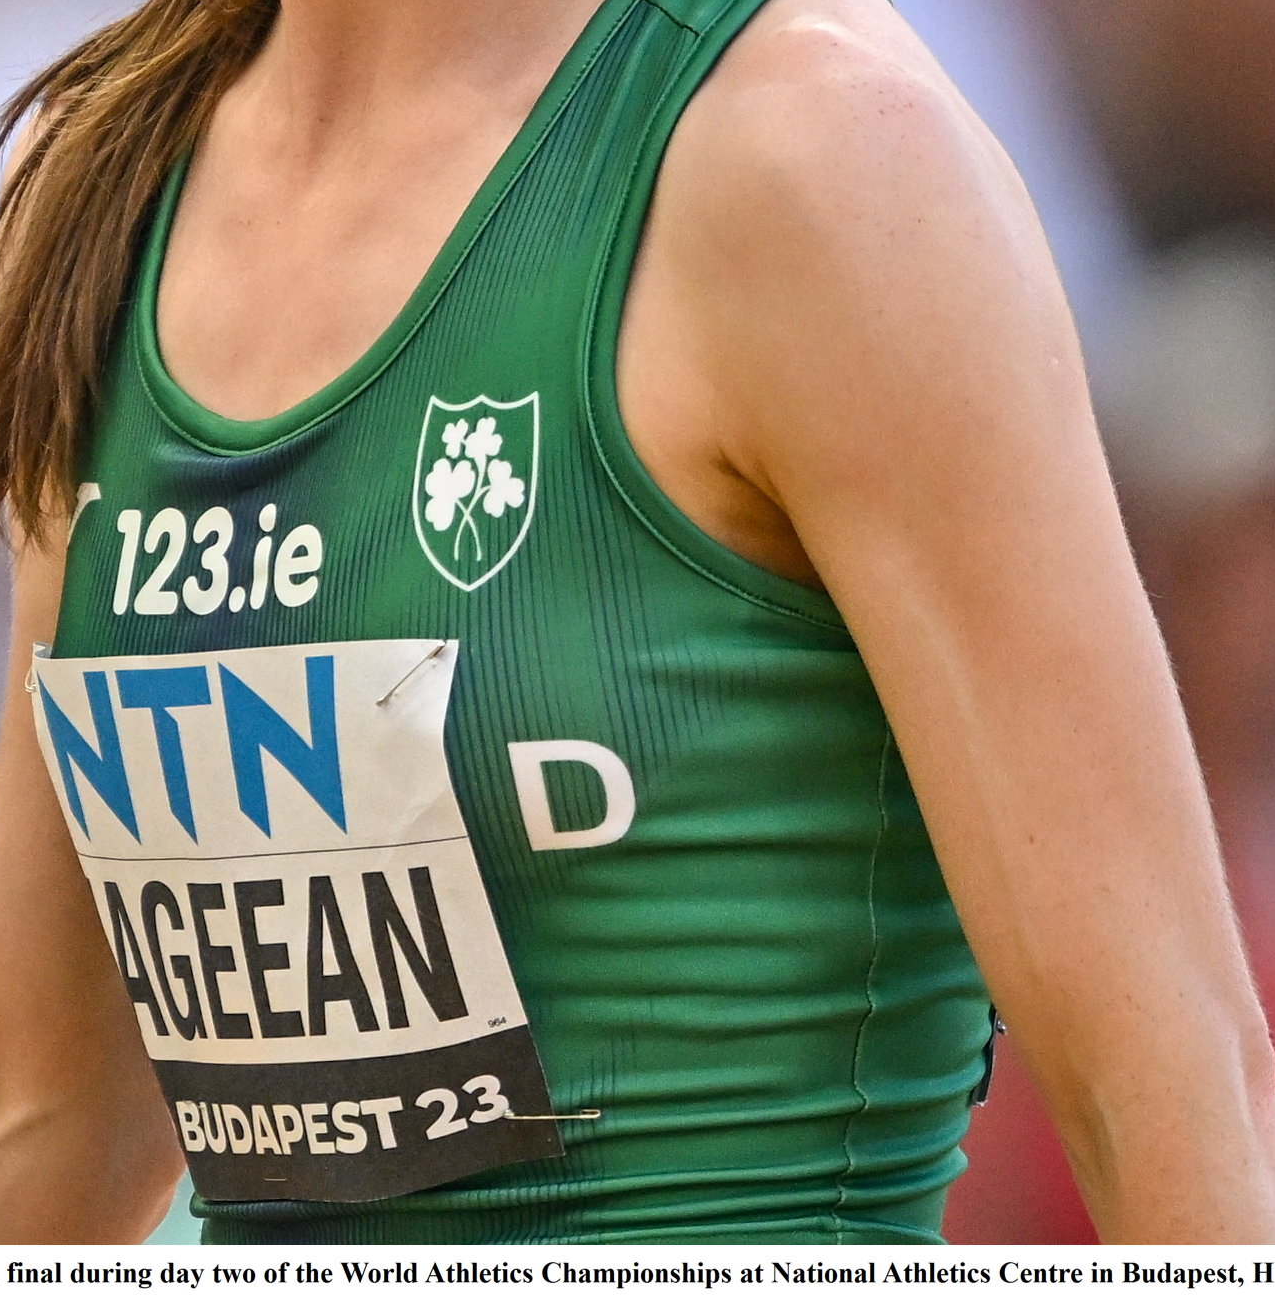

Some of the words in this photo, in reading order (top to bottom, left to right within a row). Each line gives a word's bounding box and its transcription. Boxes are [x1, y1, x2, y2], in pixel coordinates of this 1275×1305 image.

[112, 503, 323, 616] 123.ie
[36, 655, 348, 847] NTN
[507, 739, 636, 851] D
[86, 866, 469, 1041] AGEEAN
[175, 1096, 403, 1155] BUDAPEST
[415, 1074, 510, 1141] 23
